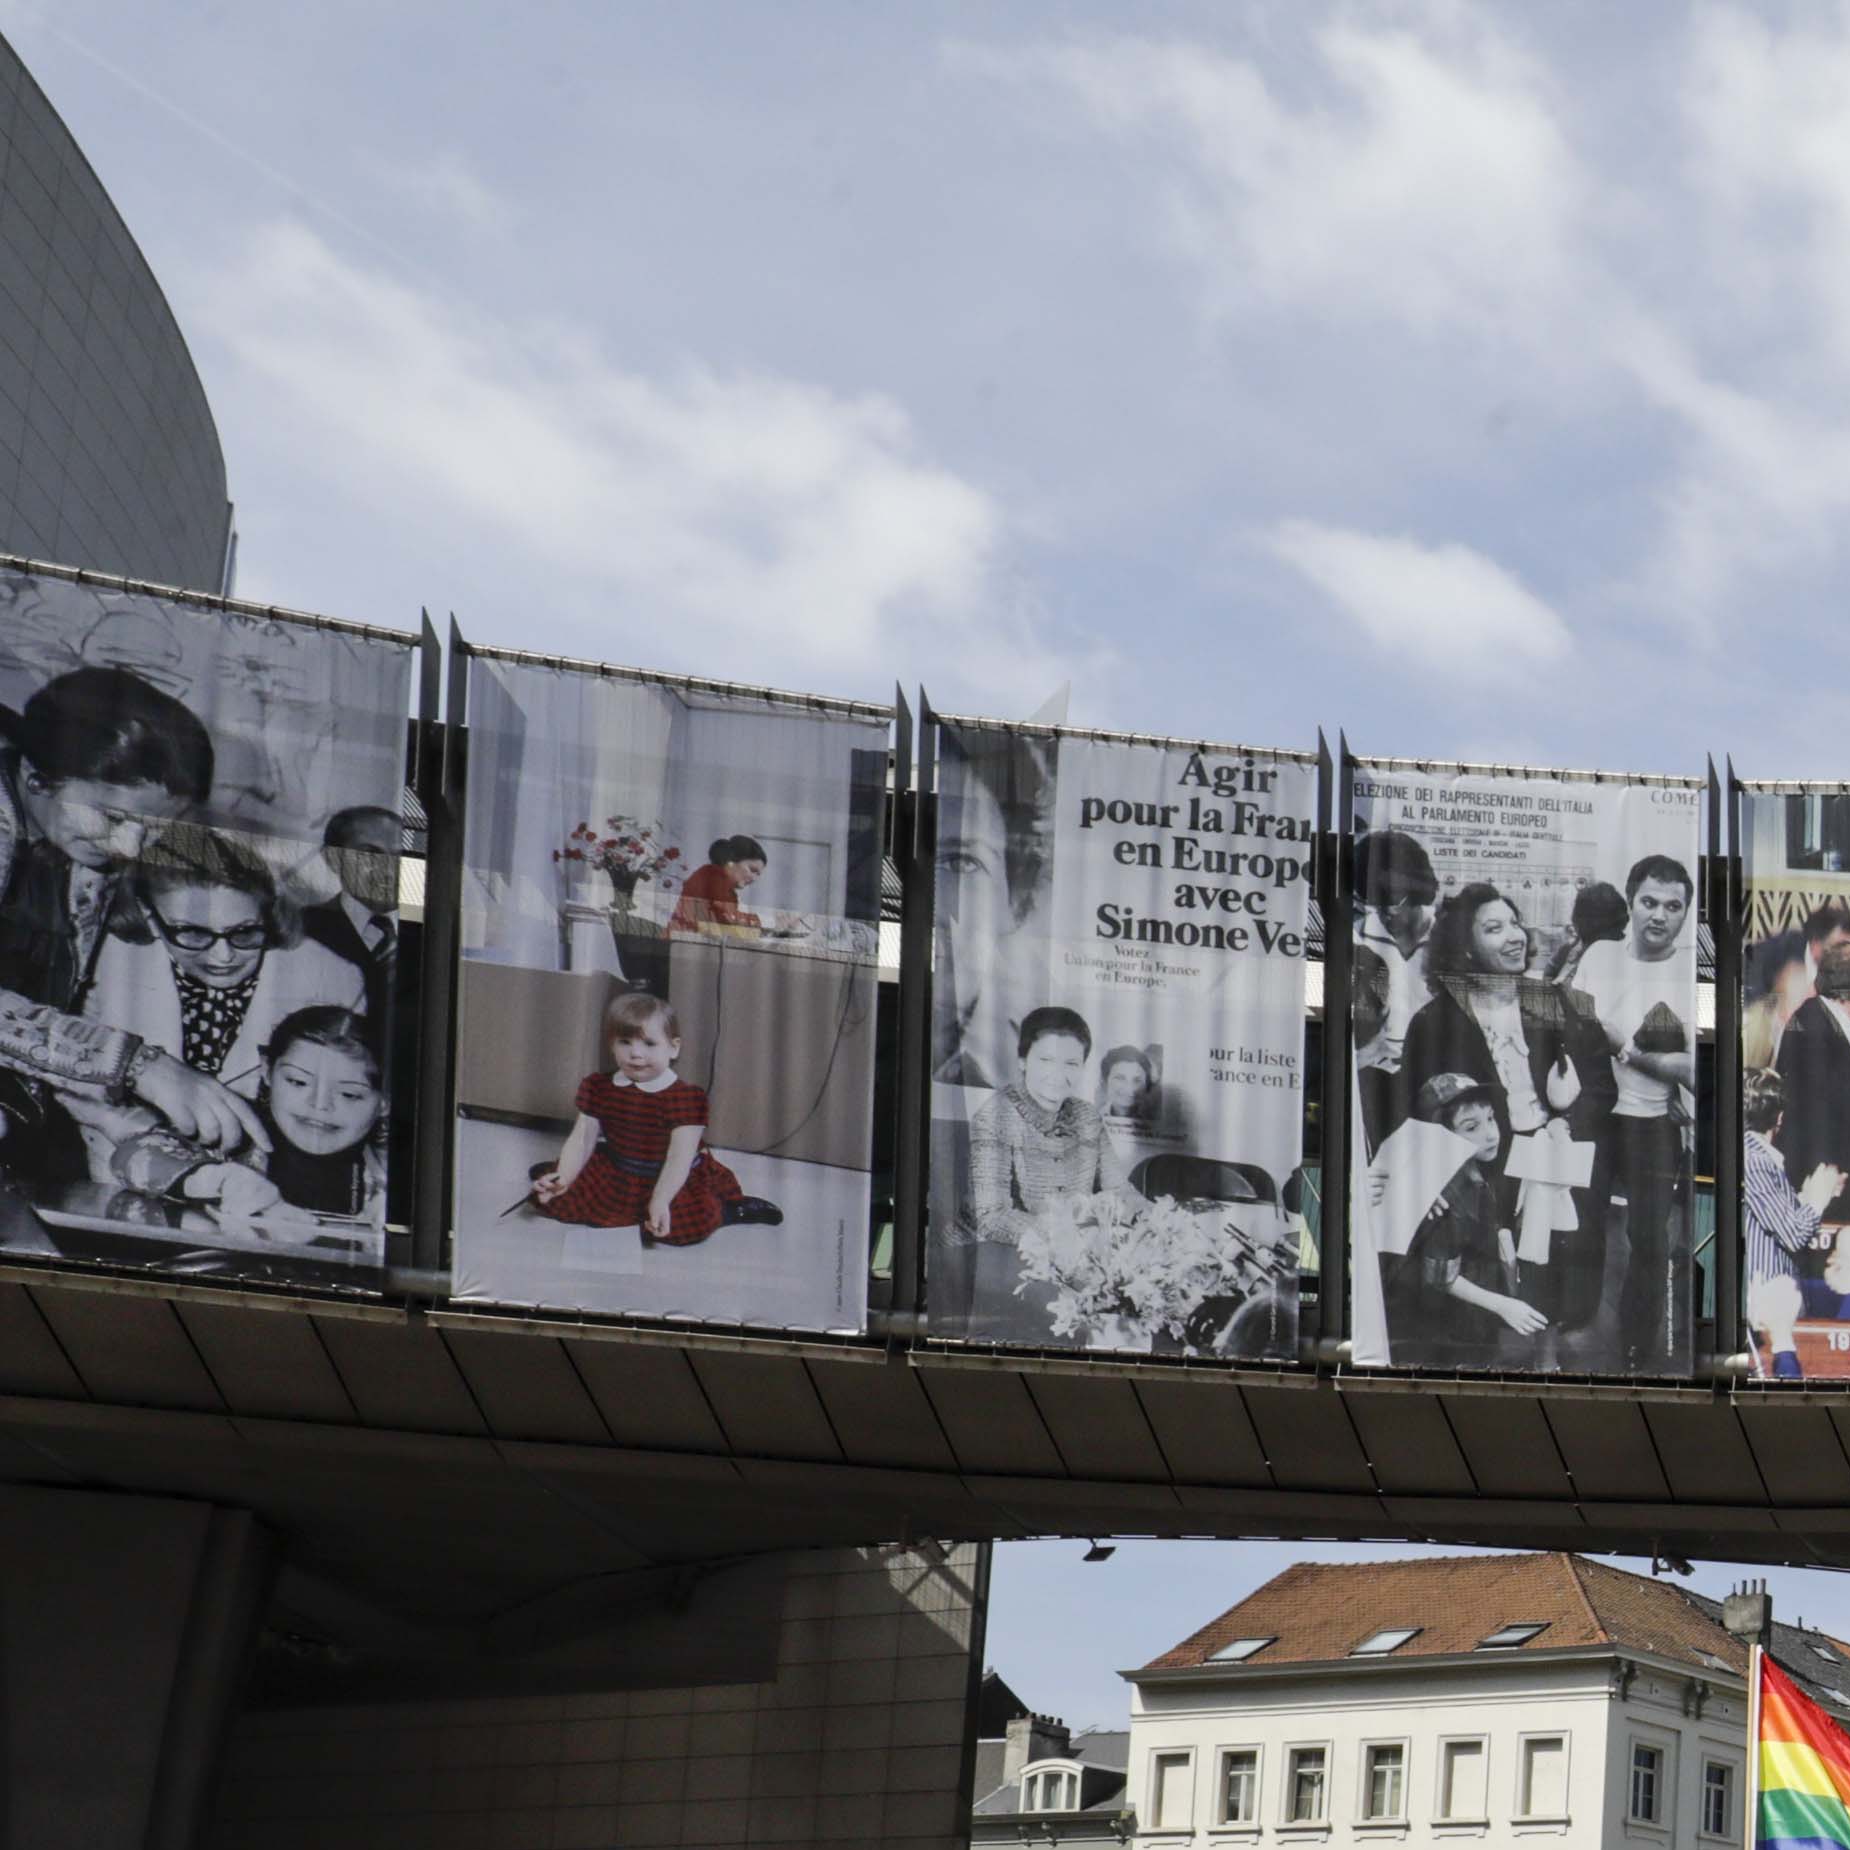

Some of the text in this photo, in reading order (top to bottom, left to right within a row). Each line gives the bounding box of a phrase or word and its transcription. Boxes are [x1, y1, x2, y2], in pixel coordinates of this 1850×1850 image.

[1178, 753, 1278, 797] Agir
[1354, 782, 1408, 800] ELEZIONE
[1415, 788, 1434, 801] DEI
[1439, 790, 1533, 810] RAPPRESENTANTI
[1080, 797, 1180, 828] pour
[1188, 797, 1224, 833] la
[1401, 805, 1547, 828] AL PARLAMENTO EUROPEO
[1113, 840, 1162, 869] en
[1434, 849, 1458, 857] LISTE
[1174, 883, 1267, 915] avec
[1096, 903, 1249, 951] Simone
[1257, 1048, 1296, 1068] liste
[1262, 1074, 1284, 1088] en
